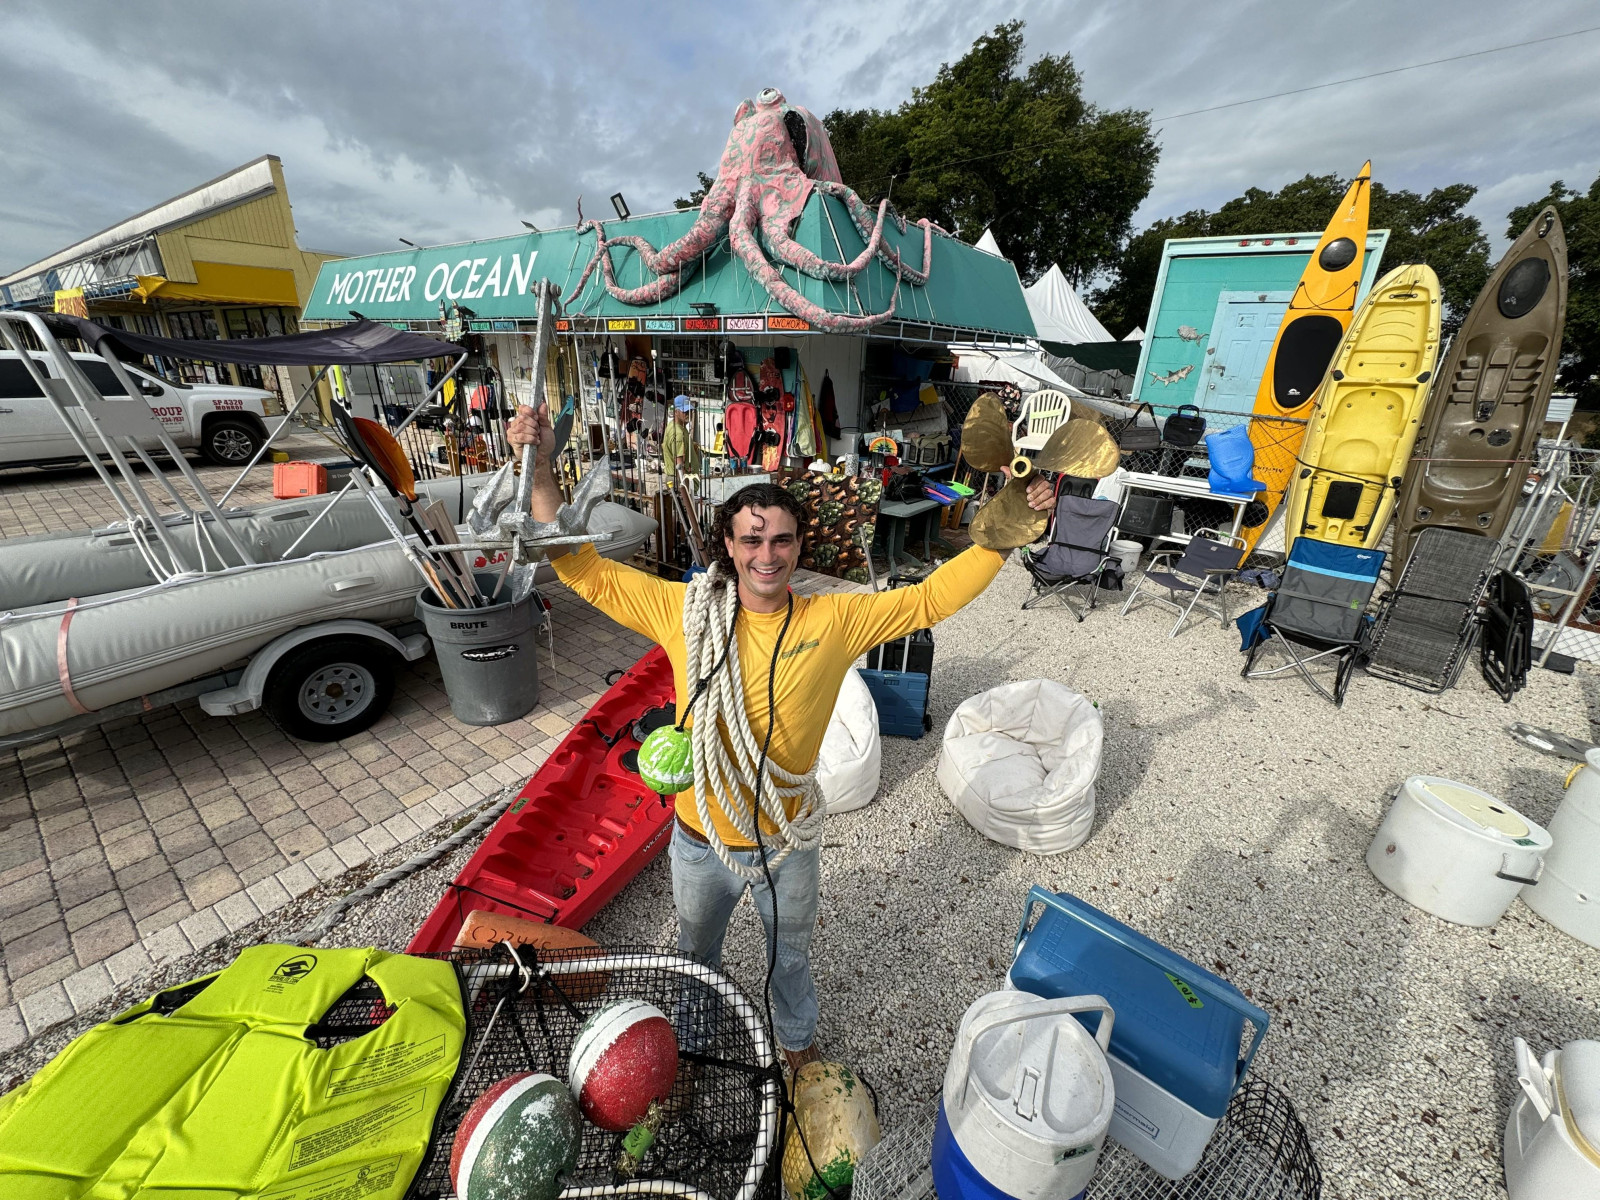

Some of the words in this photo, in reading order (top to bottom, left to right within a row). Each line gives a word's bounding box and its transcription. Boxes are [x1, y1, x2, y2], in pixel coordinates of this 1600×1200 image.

[326, 266, 417, 305] MOTHER
[424, 251, 539, 302] OCEAN
[151, 406, 183, 416] ROUP
[450, 620, 489, 630] BRUTE
